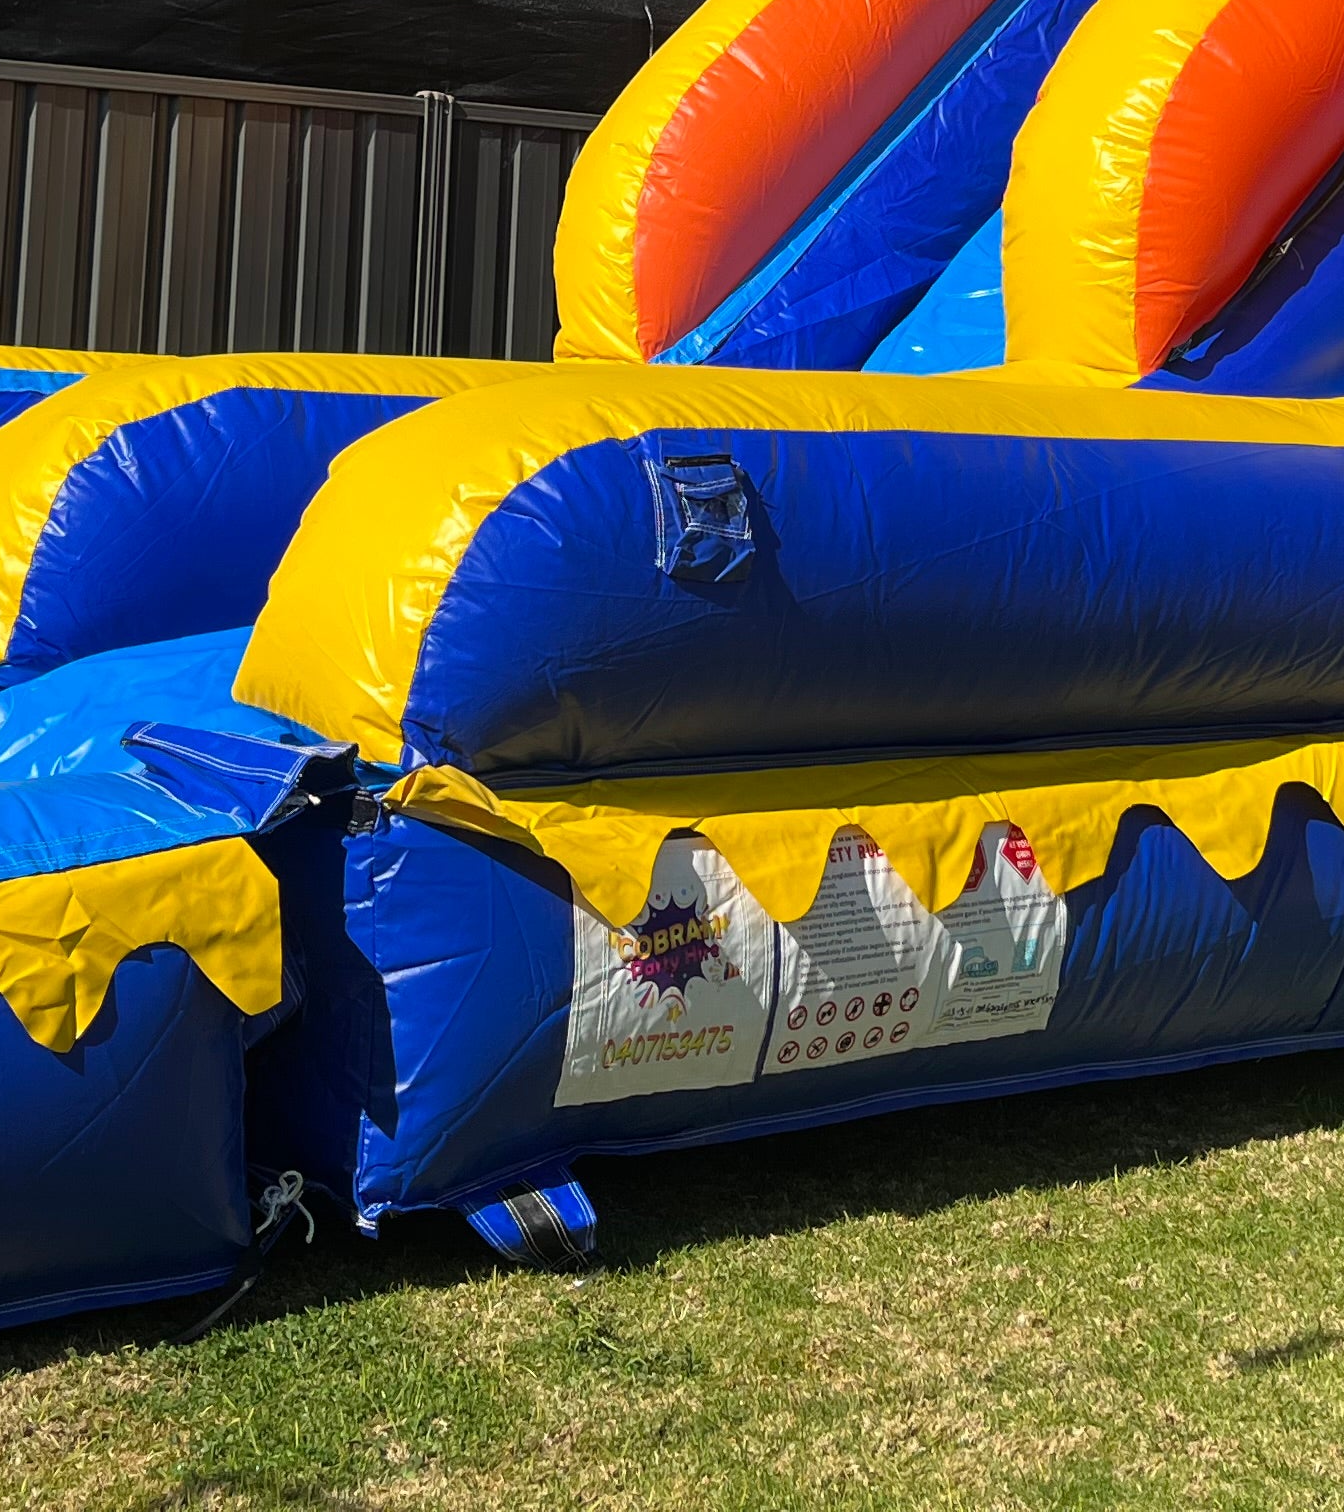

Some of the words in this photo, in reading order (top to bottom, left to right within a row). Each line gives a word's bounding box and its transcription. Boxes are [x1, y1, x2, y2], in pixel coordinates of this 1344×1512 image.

[828, 846, 853, 863] ETY
[858, 842, 885, 859] RUL
[617, 915, 722, 963] COBRAM
[602, 1025, 734, 1069] 0407153475
